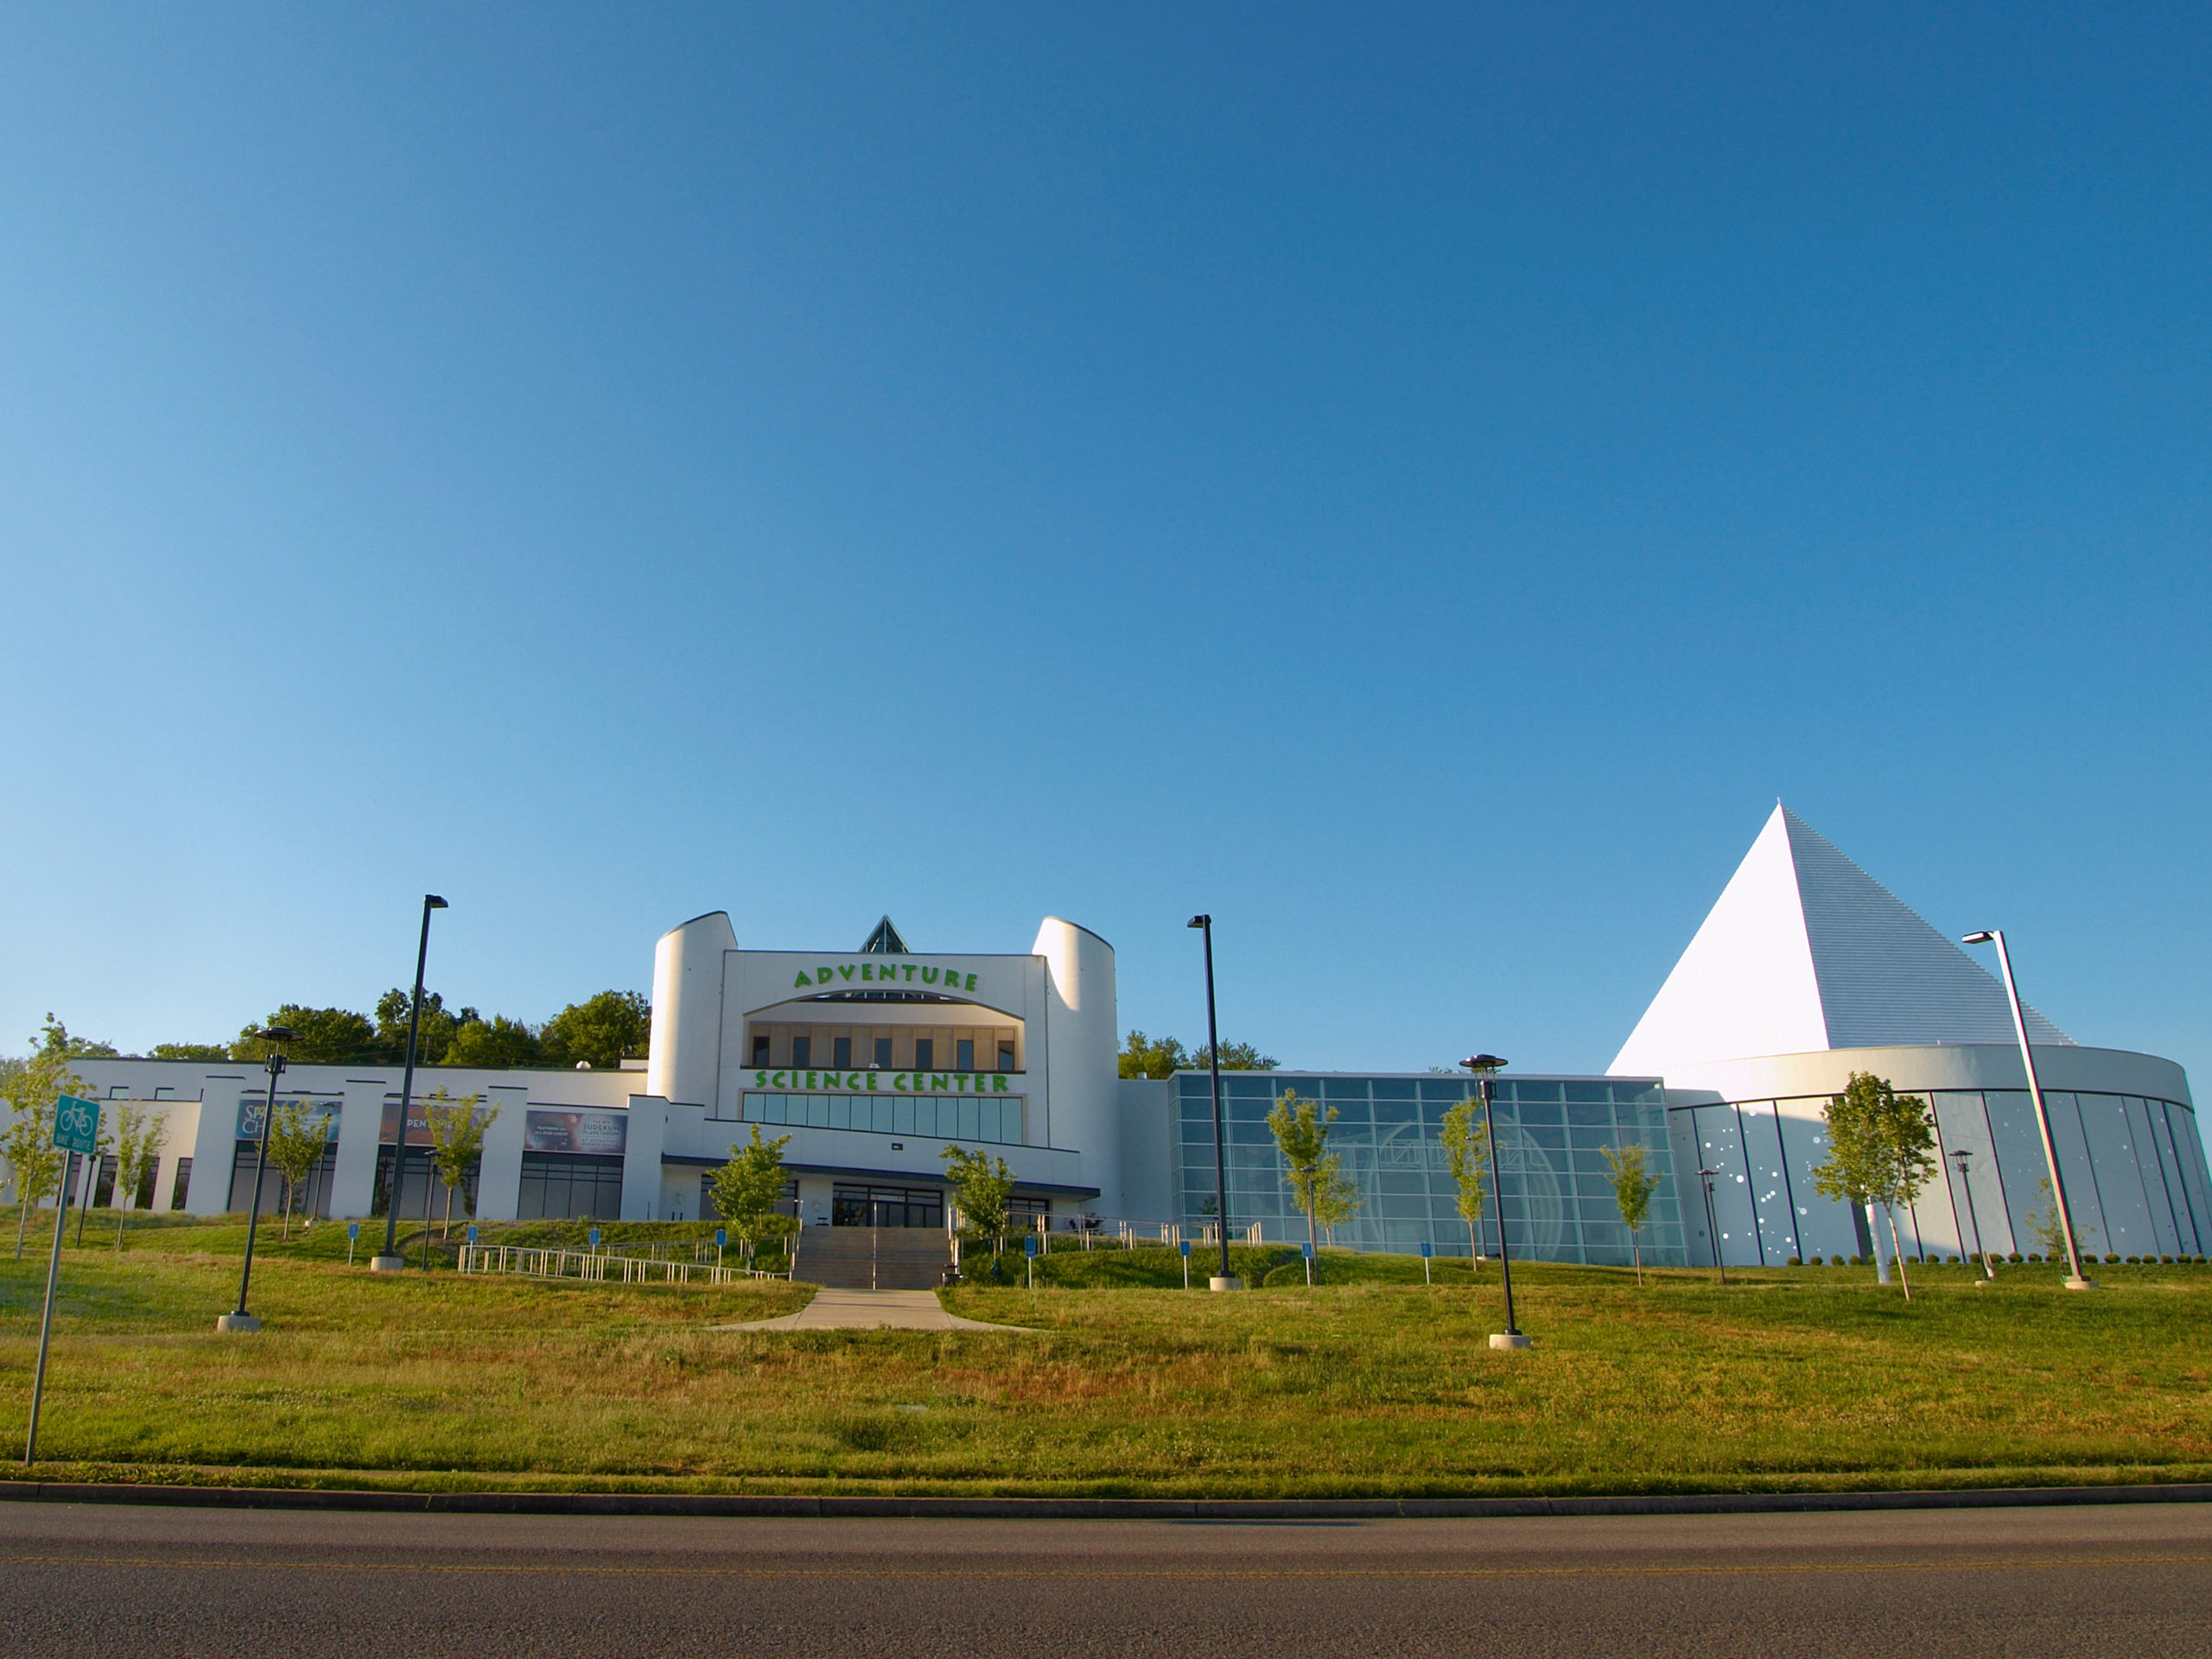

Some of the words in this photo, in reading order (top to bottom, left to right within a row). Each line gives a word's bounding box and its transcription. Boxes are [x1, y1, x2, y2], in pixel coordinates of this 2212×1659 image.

[794, 963, 978, 992] ADVENTURE
[755, 1070, 878, 1090] SCIENCE
[893, 1072, 1009, 1092] CENTER
[407, 1119, 427, 1128] PEN
